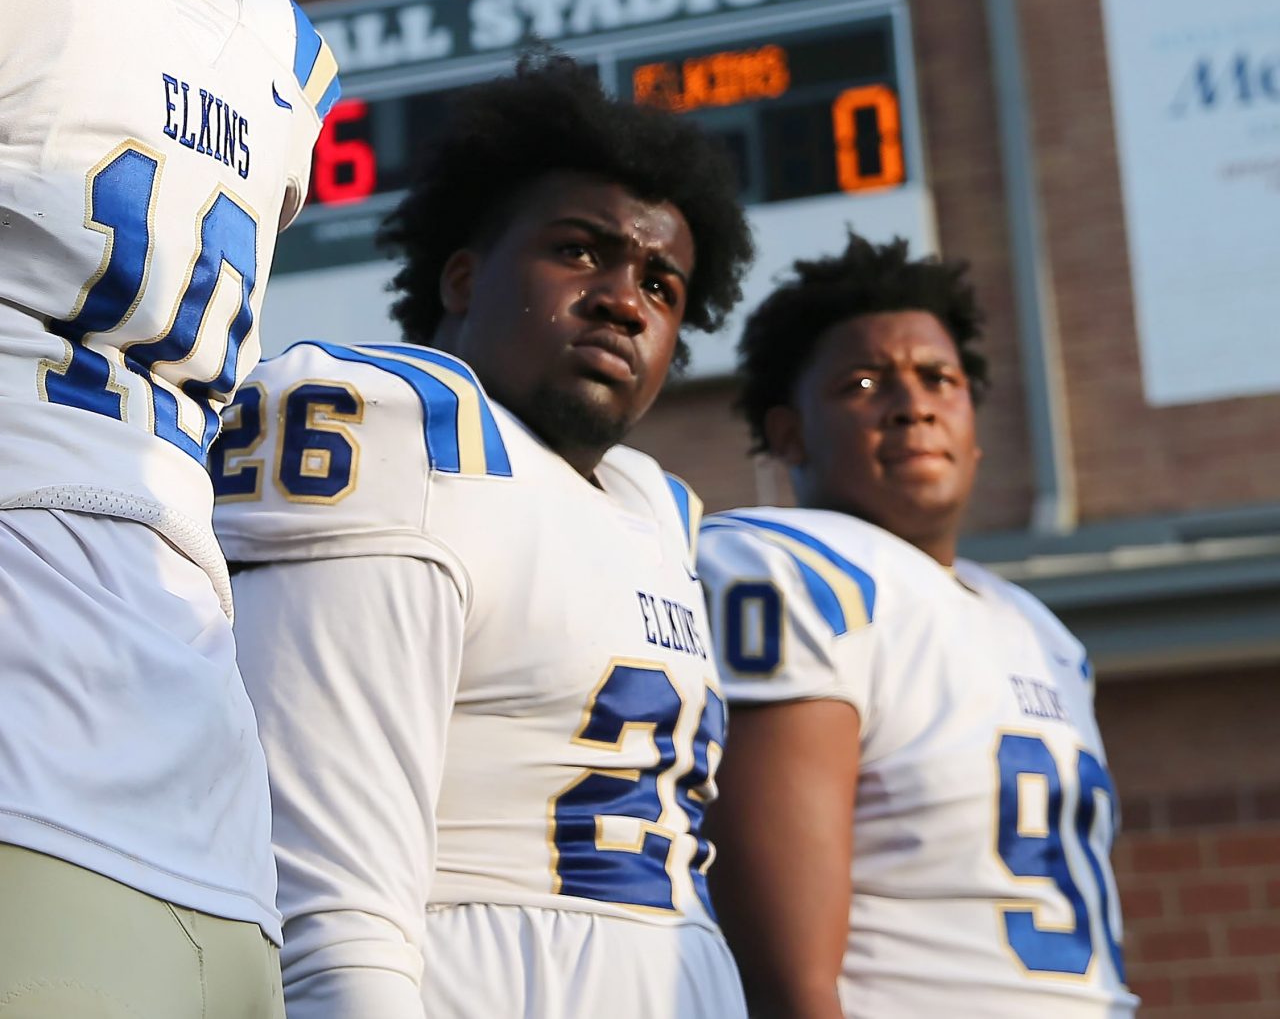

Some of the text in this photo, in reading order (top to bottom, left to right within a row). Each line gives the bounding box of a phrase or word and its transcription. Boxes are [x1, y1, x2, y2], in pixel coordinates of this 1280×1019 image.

[162, 72, 250, 180] ELKINS
[314, 98, 378, 209] 6
[832, 85, 904, 196] 0
[36, 139, 260, 469] 10
[208, 378, 365, 506] 26
[636, 590, 708, 661] ELKINS
[723, 576, 788, 680] 0
